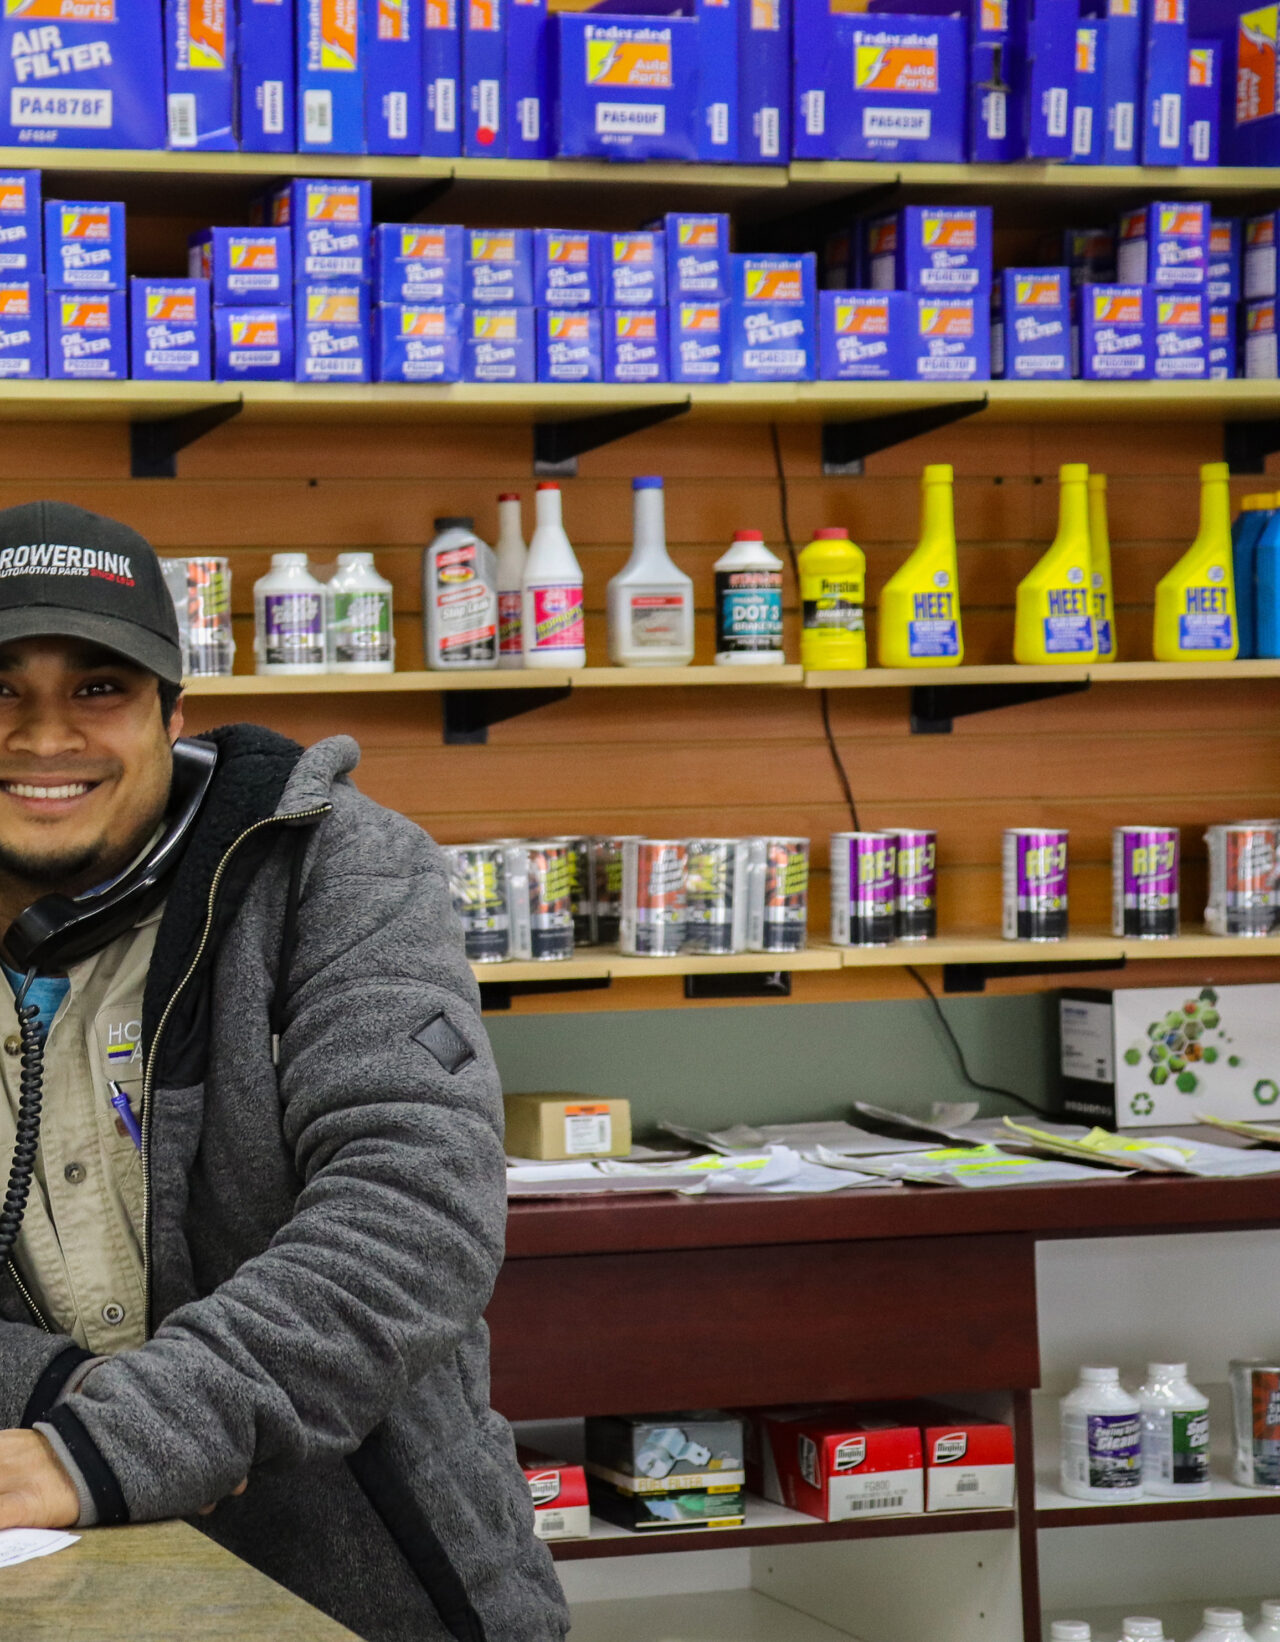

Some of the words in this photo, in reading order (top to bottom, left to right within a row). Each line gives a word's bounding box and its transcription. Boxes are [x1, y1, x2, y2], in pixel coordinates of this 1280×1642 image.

[60, 2, 111, 17] Parts
[585, 24, 672, 41] Federated
[853, 30, 939, 46] Federated
[11, 25, 63, 58] AIR
[14, 41, 113, 83] FILTER
[635, 59, 667, 71] Auto
[902, 64, 935, 76] Auto
[629, 70, 669, 84] Parts
[896, 75, 935, 88] Parts
[19, 96, 105, 116] PA4878F
[307, 228, 334, 243] OIL
[61, 243, 87, 257] OIL
[311, 234, 360, 255] FILTER
[64, 249, 112, 269] FILTER
[744, 312, 775, 330] OIL
[61, 332, 87, 347] OIL
[146, 325, 172, 339] OIL
[307, 329, 334, 344] OIL
[747, 319, 805, 346] FILTER
[64, 338, 112, 359] FILTER
[149, 331, 196, 351] FILTER
[311, 335, 360, 357] FILTER
[57, 566, 89, 577] PARTS
[913, 592, 953, 618] HEET
[1048, 588, 1087, 615] HEET
[1185, 587, 1228, 614] HEET
[733, 605, 769, 621] DOT
[771, 606, 780, 620] 3
[733, 621, 766, 632] BRAKE
[638, 1477, 664, 1491] FUEL
[667, 1476, 703, 1489] FILTER
